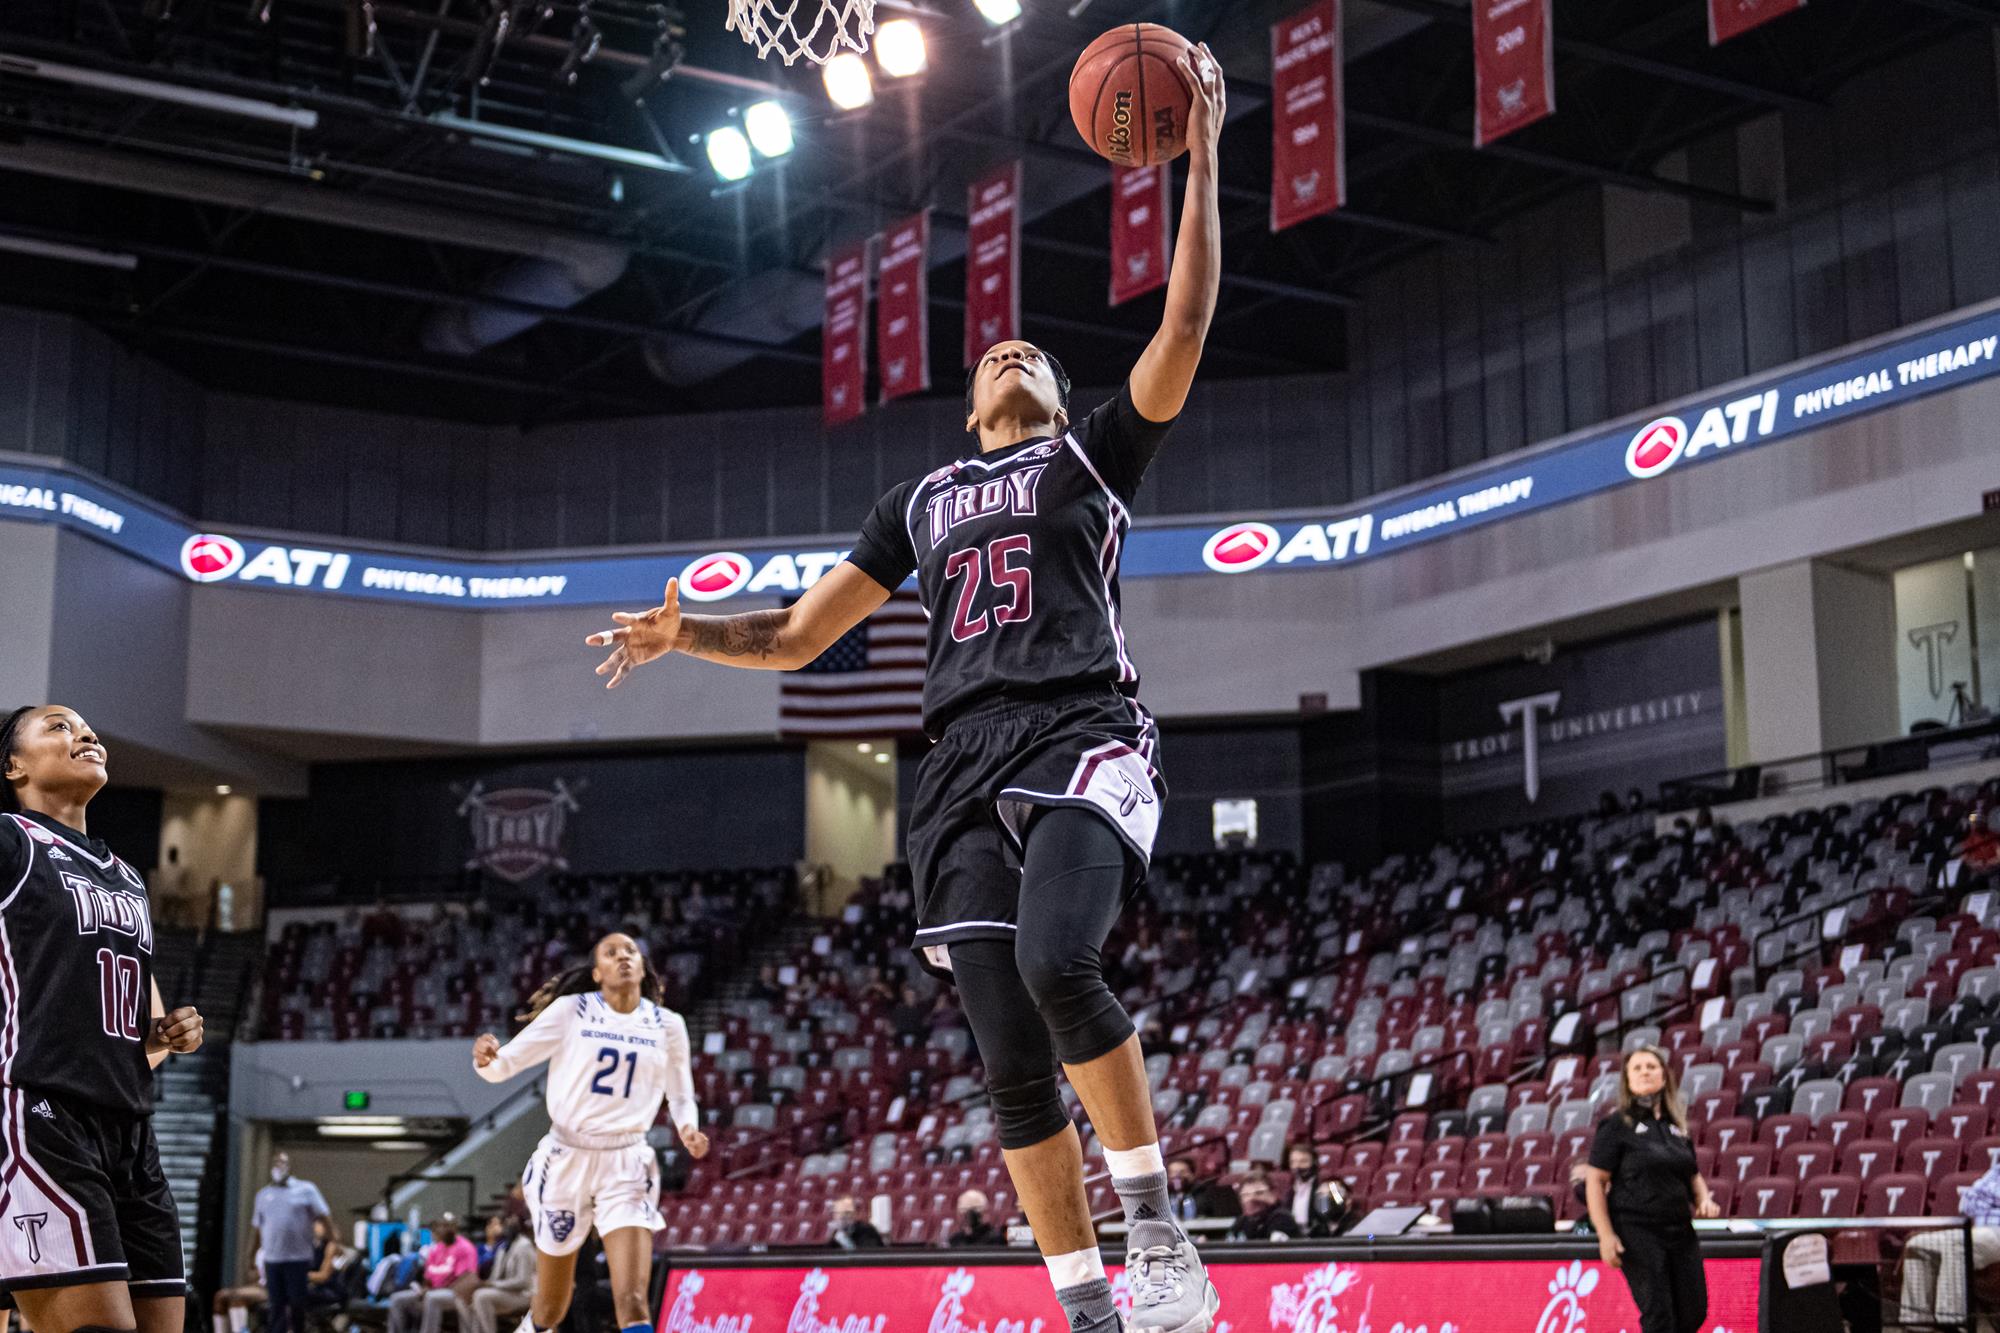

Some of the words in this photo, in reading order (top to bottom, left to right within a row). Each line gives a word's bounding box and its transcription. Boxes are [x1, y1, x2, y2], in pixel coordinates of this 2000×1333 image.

[1684, 389, 1779, 457] ATI
[1794, 369, 1893, 418] PHYSICAL
[1897, 335, 1998, 386] THERAPY
[925, 463, 1049, 550] TROY
[1275, 513, 1374, 563] ATI
[1381, 500, 1457, 540] PHYSICAL
[1457, 476, 1534, 517] THERAPY
[239, 546, 351, 589] ATI
[362, 567, 466, 597] PHYSICAL
[468, 575, 567, 599] THERAPY
[747, 551, 852, 593] AT
[945, 533, 1032, 642] 25
[1552, 693, 1701, 742] UNIVERSITY
[59, 870, 153, 955] TROY
[97, 947, 141, 1041] 10
[581, 1029, 625, 1042] GEORGIA
[628, 1035, 657, 1047] STATE
[591, 1046, 638, 1098] 21
